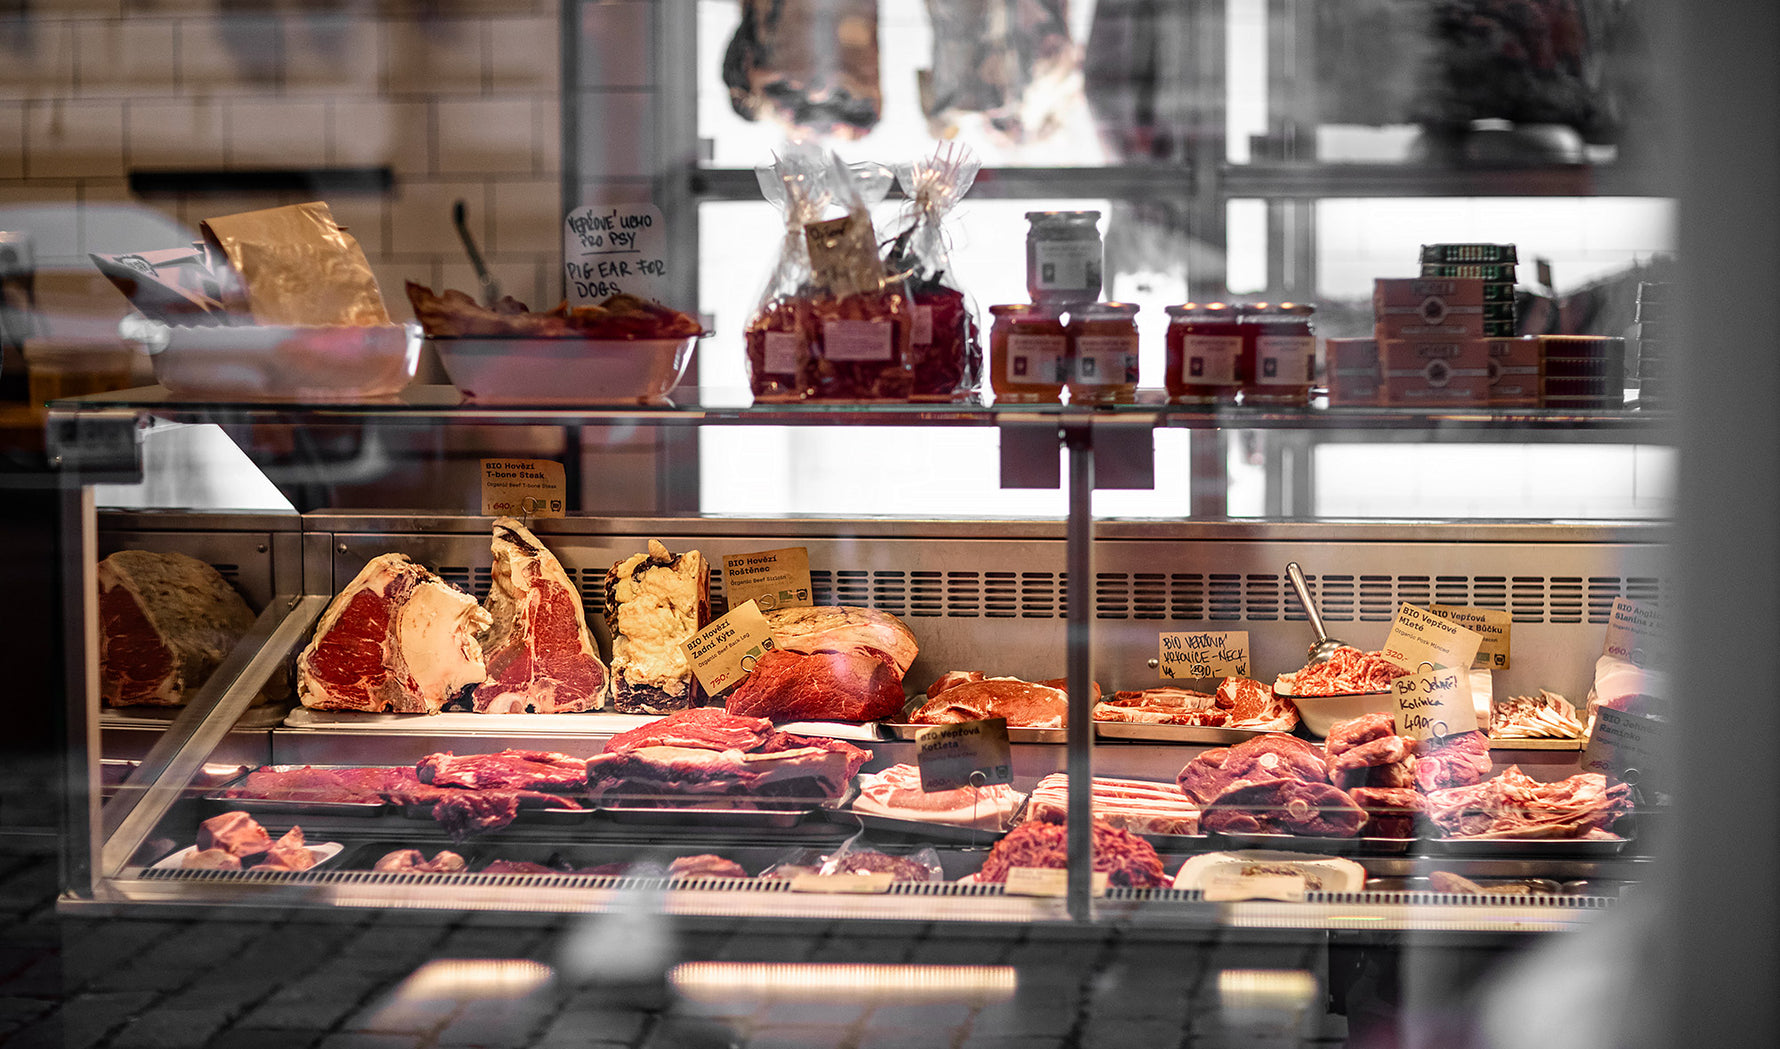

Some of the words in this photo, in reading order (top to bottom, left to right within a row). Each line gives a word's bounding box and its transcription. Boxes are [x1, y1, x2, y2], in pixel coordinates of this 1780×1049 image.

[579, 234, 603, 247] PRO
[608, 232, 636, 249] PSY
[567, 262, 594, 279] PIG
[598, 262, 632, 278] EAR
[636, 259, 666, 276] FOR
[574, 281, 622, 298] DOGS
[486, 470, 517, 478] T-bone
[520, 471, 545, 479] Steak
[728, 559, 744, 568] BIO
[746, 554, 777, 565] Hovězí
[729, 566, 770, 576] Roštěnec
[1617, 603, 1632, 612] BIO
[1402, 606, 1420, 619] BIO
[1422, 614, 1458, 635] Vepřové
[1432, 610, 1448, 618] BIO
[1450, 611, 1486, 622] Vepřová
[1615, 612, 1647, 626] Slanina
[1398, 616, 1424, 632] Mleté
[1476, 624, 1503, 634] Bůčku
[686, 638, 702, 651] BIO
[702, 618, 730, 640] Hovězí
[1394, 628, 1417, 640] Organic
[1417, 636, 1429, 645] Pork
[692, 642, 716, 660] Zadní
[716, 628, 736, 644] Kýta
[698, 652, 718, 668] Organic
[718, 645, 729, 656] Beef
[729, 638, 740, 649] Back
[740, 632, 750, 641] Leg
[1385, 648, 1408, 661] 320,-
[710, 672, 730, 689] 750,-
[1603, 712, 1620, 724] BIO
[920, 732, 938, 741] BIO
[941, 727, 980, 739] Vepřová
[921, 741, 959, 752] Kotleta
